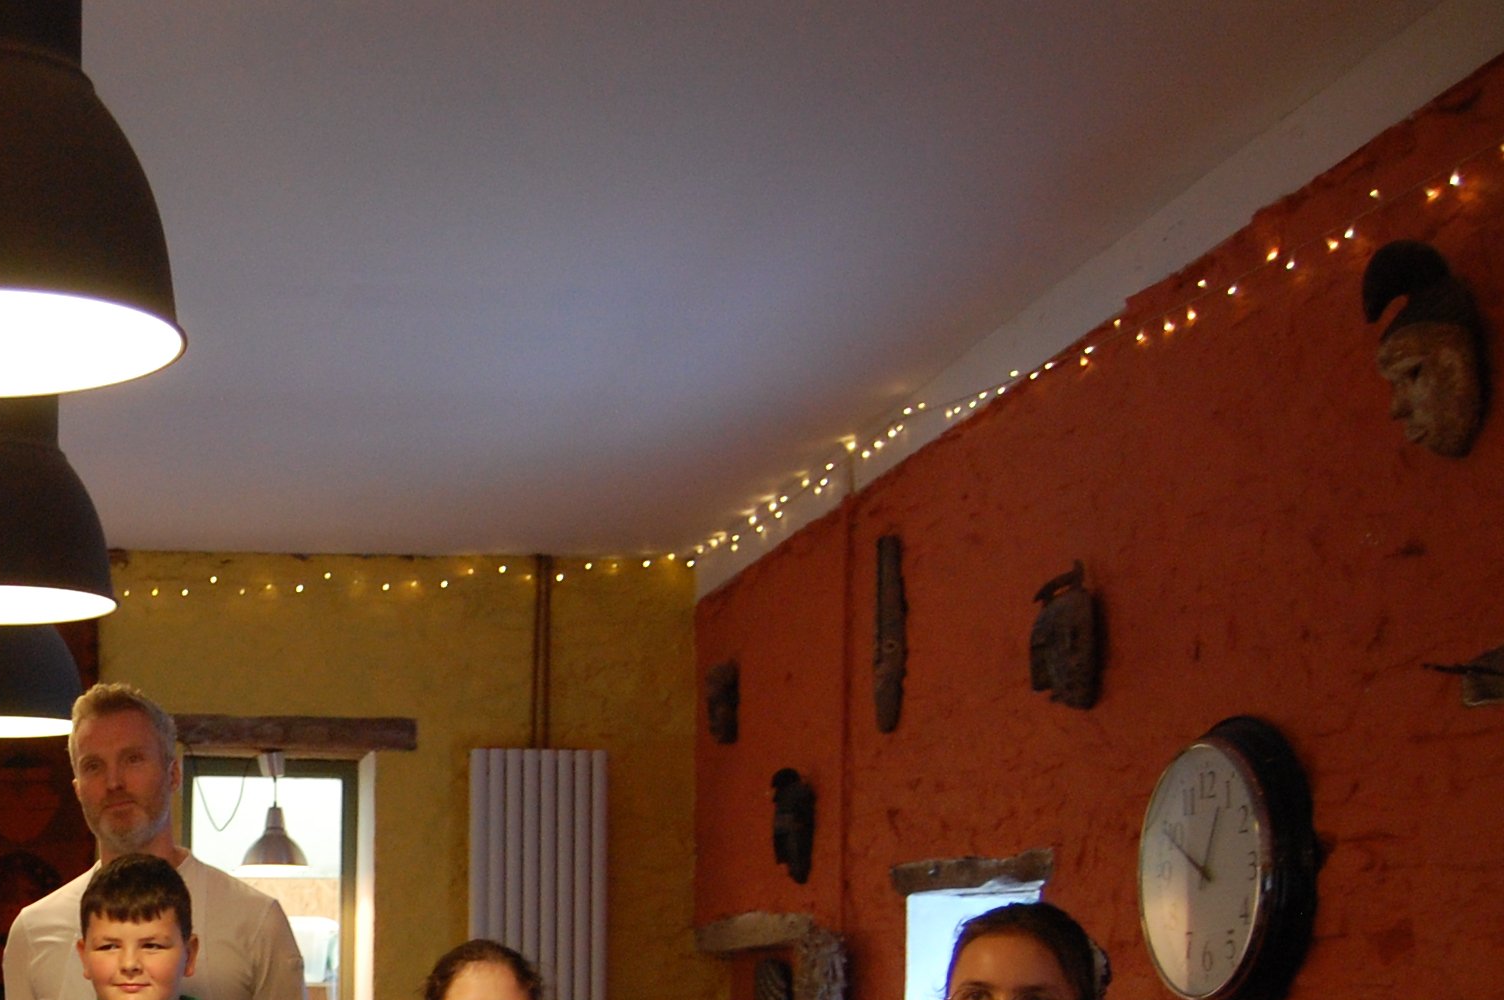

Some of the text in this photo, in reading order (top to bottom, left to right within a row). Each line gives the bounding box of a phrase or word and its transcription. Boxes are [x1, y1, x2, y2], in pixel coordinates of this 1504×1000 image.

[1199, 770, 1216, 800] 12
[1224, 779, 1232, 809] 1
[1182, 787, 1195, 816] 11
[1238, 805, 1250, 834] 2
[1247, 850, 1257, 881] 3
[1201, 939, 1214, 972] 6
[1225, 928, 1237, 961] 5
